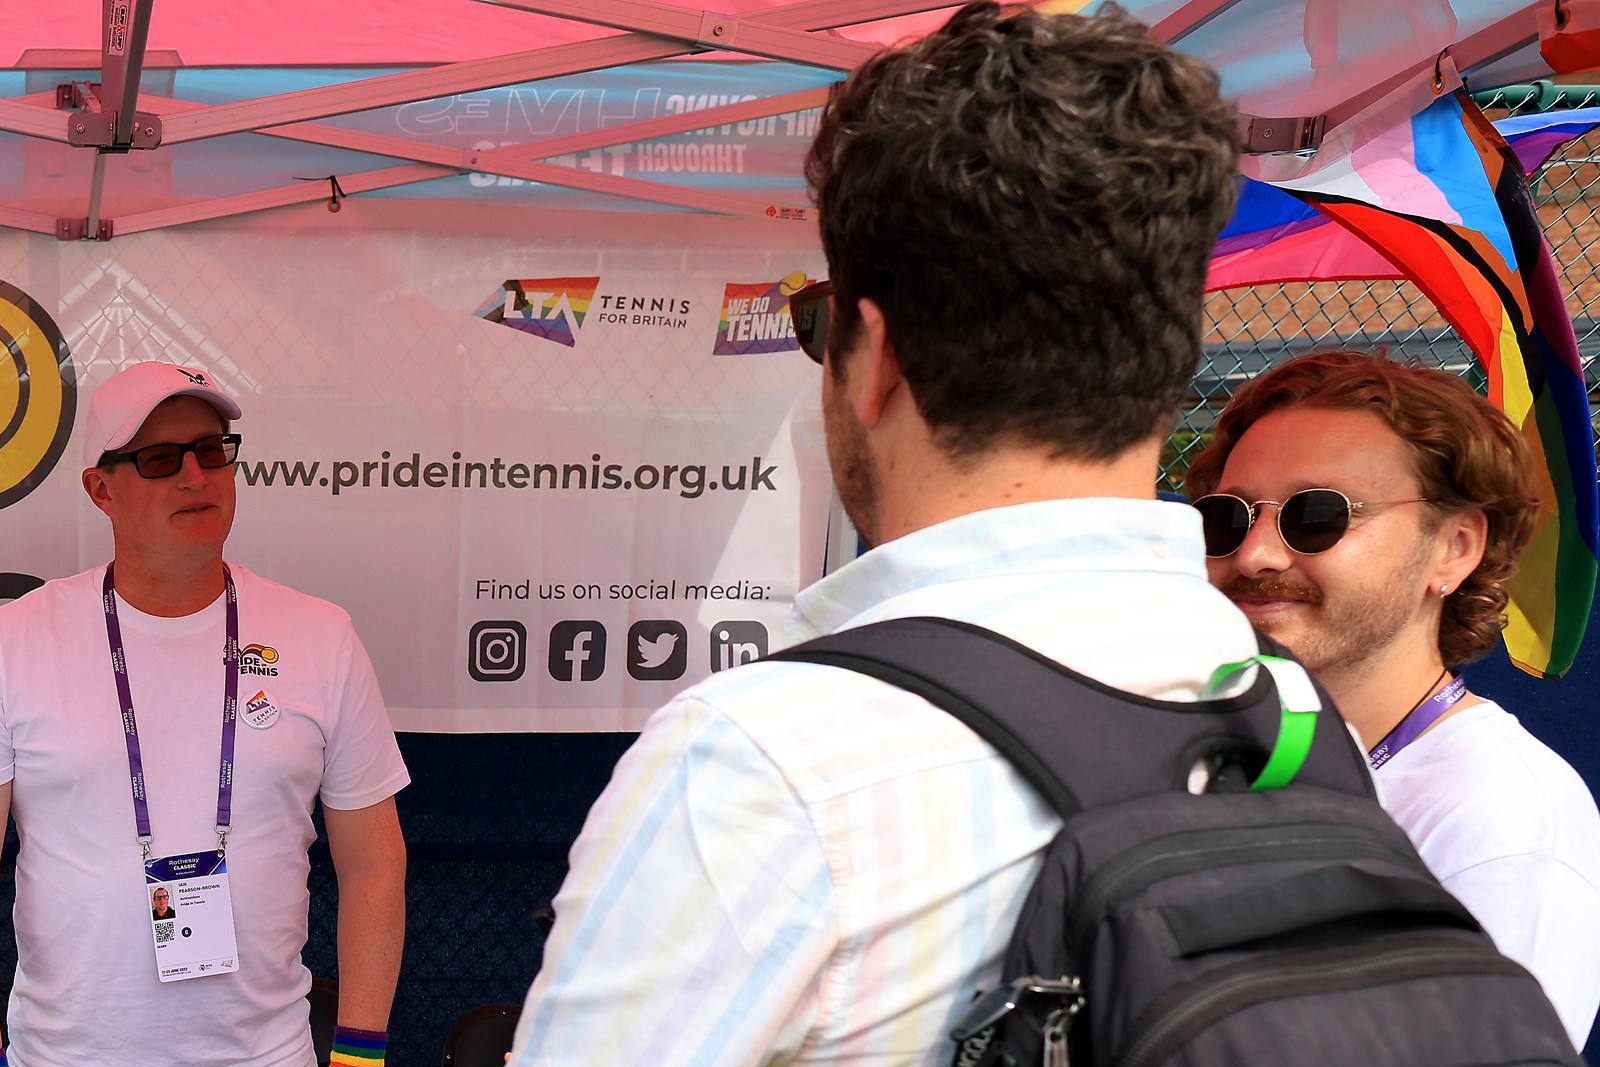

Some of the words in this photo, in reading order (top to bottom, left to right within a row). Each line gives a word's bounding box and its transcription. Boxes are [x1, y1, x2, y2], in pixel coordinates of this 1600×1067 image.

[600, 296, 691, 315] TENNIS
[728, 298, 749, 317] WE
[750, 297, 771, 316] DO
[599, 313, 627, 325] FOR
[632, 315, 688, 329] BRITAIN
[234, 452, 777, 500] ww.prideintennis.org.uk
[476, 580, 531, 600] Find
[538, 585, 566, 600] us
[573, 585, 602, 600] on
[609, 579, 676, 600] social
[684, 580, 772, 601] media:
[238, 666, 279, 677] ENNIS
[122, 712, 131, 734] CLASSIC
[127, 708, 136, 737] Rothesay
[252, 705, 276, 723] TENNIS
[221, 759, 229, 789] Rothesay
[132, 776, 140, 799] CLASSIC
[136, 772, 145, 801] Rothesay
[169, 858, 199, 866] Rothesay
